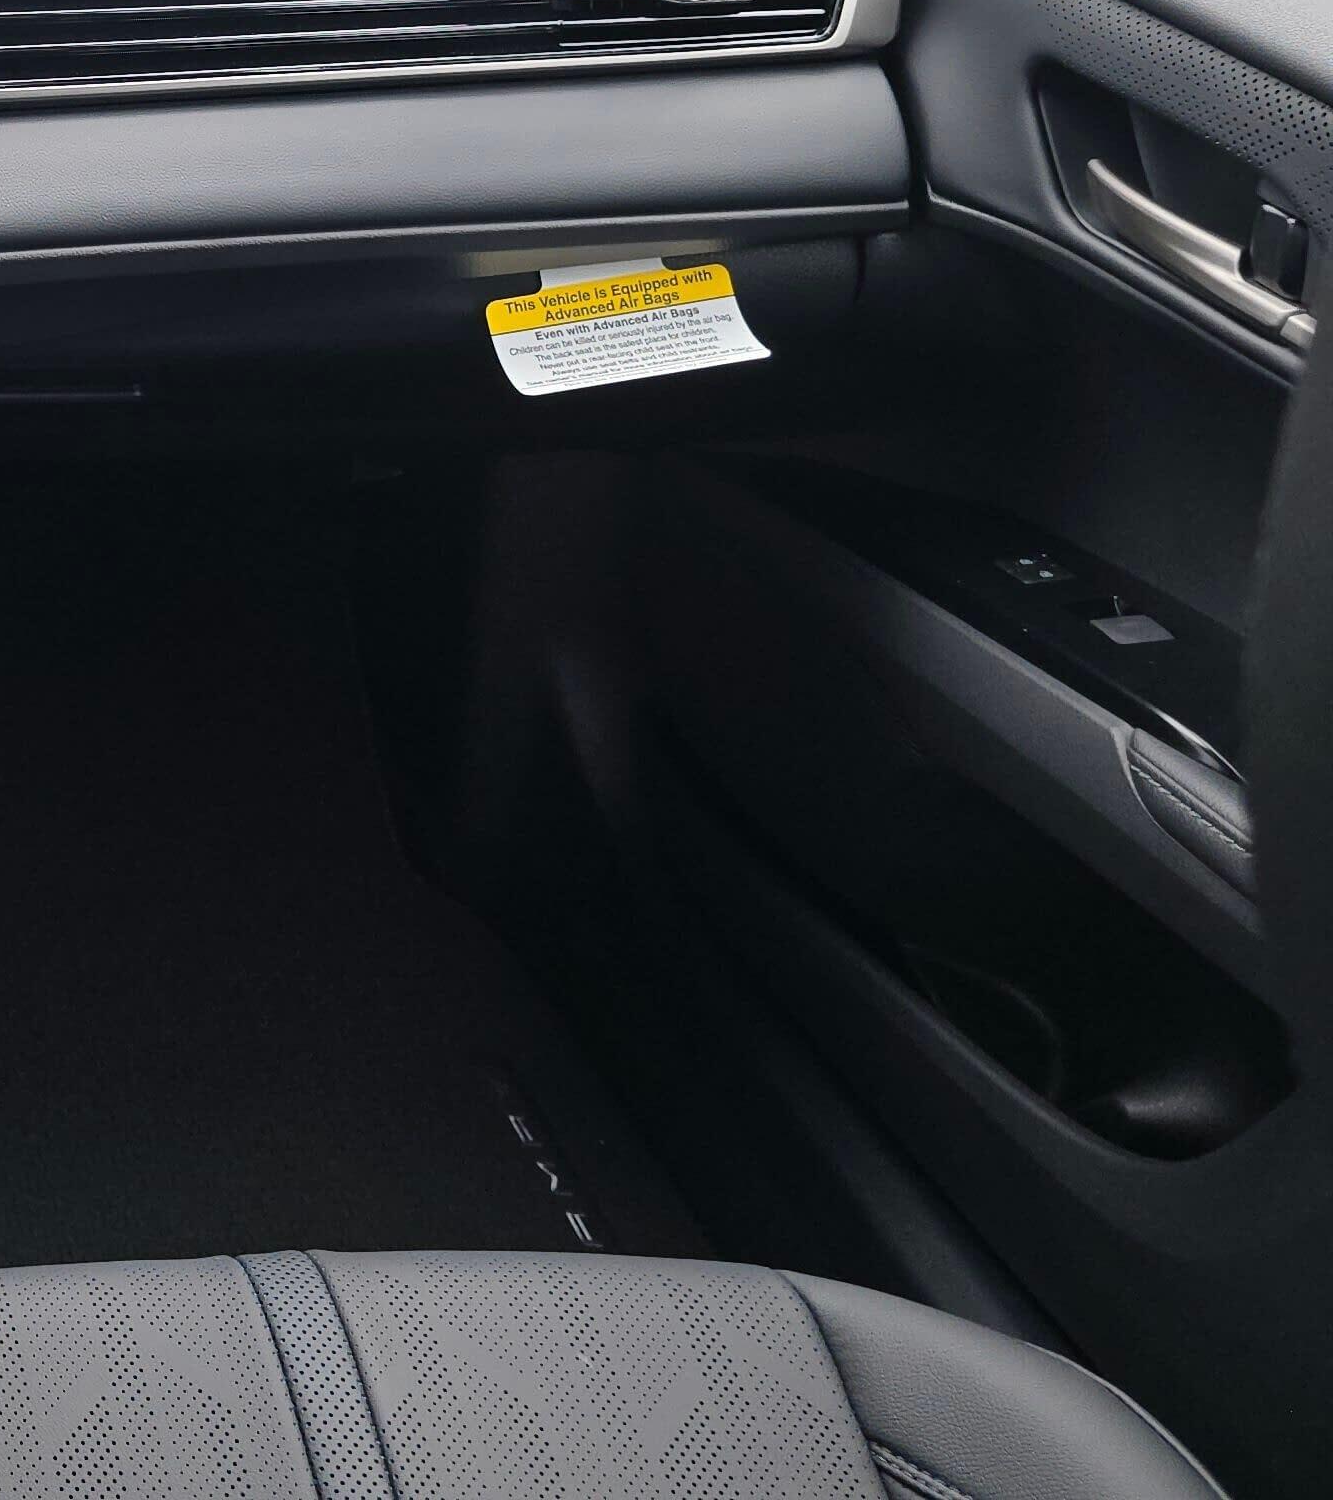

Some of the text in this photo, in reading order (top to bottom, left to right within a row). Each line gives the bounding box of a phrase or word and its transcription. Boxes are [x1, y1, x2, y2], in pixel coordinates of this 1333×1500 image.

[503, 297, 536, 314] This
[538, 288, 591, 308] Vehicle
[611, 274, 678, 299] Equipped
[680, 268, 712, 285] with
[544, 288, 680, 322] Advanced Air Bags
[534, 304, 700, 341] Even with Advanced Air Bags
[509, 342, 544, 356] Children
